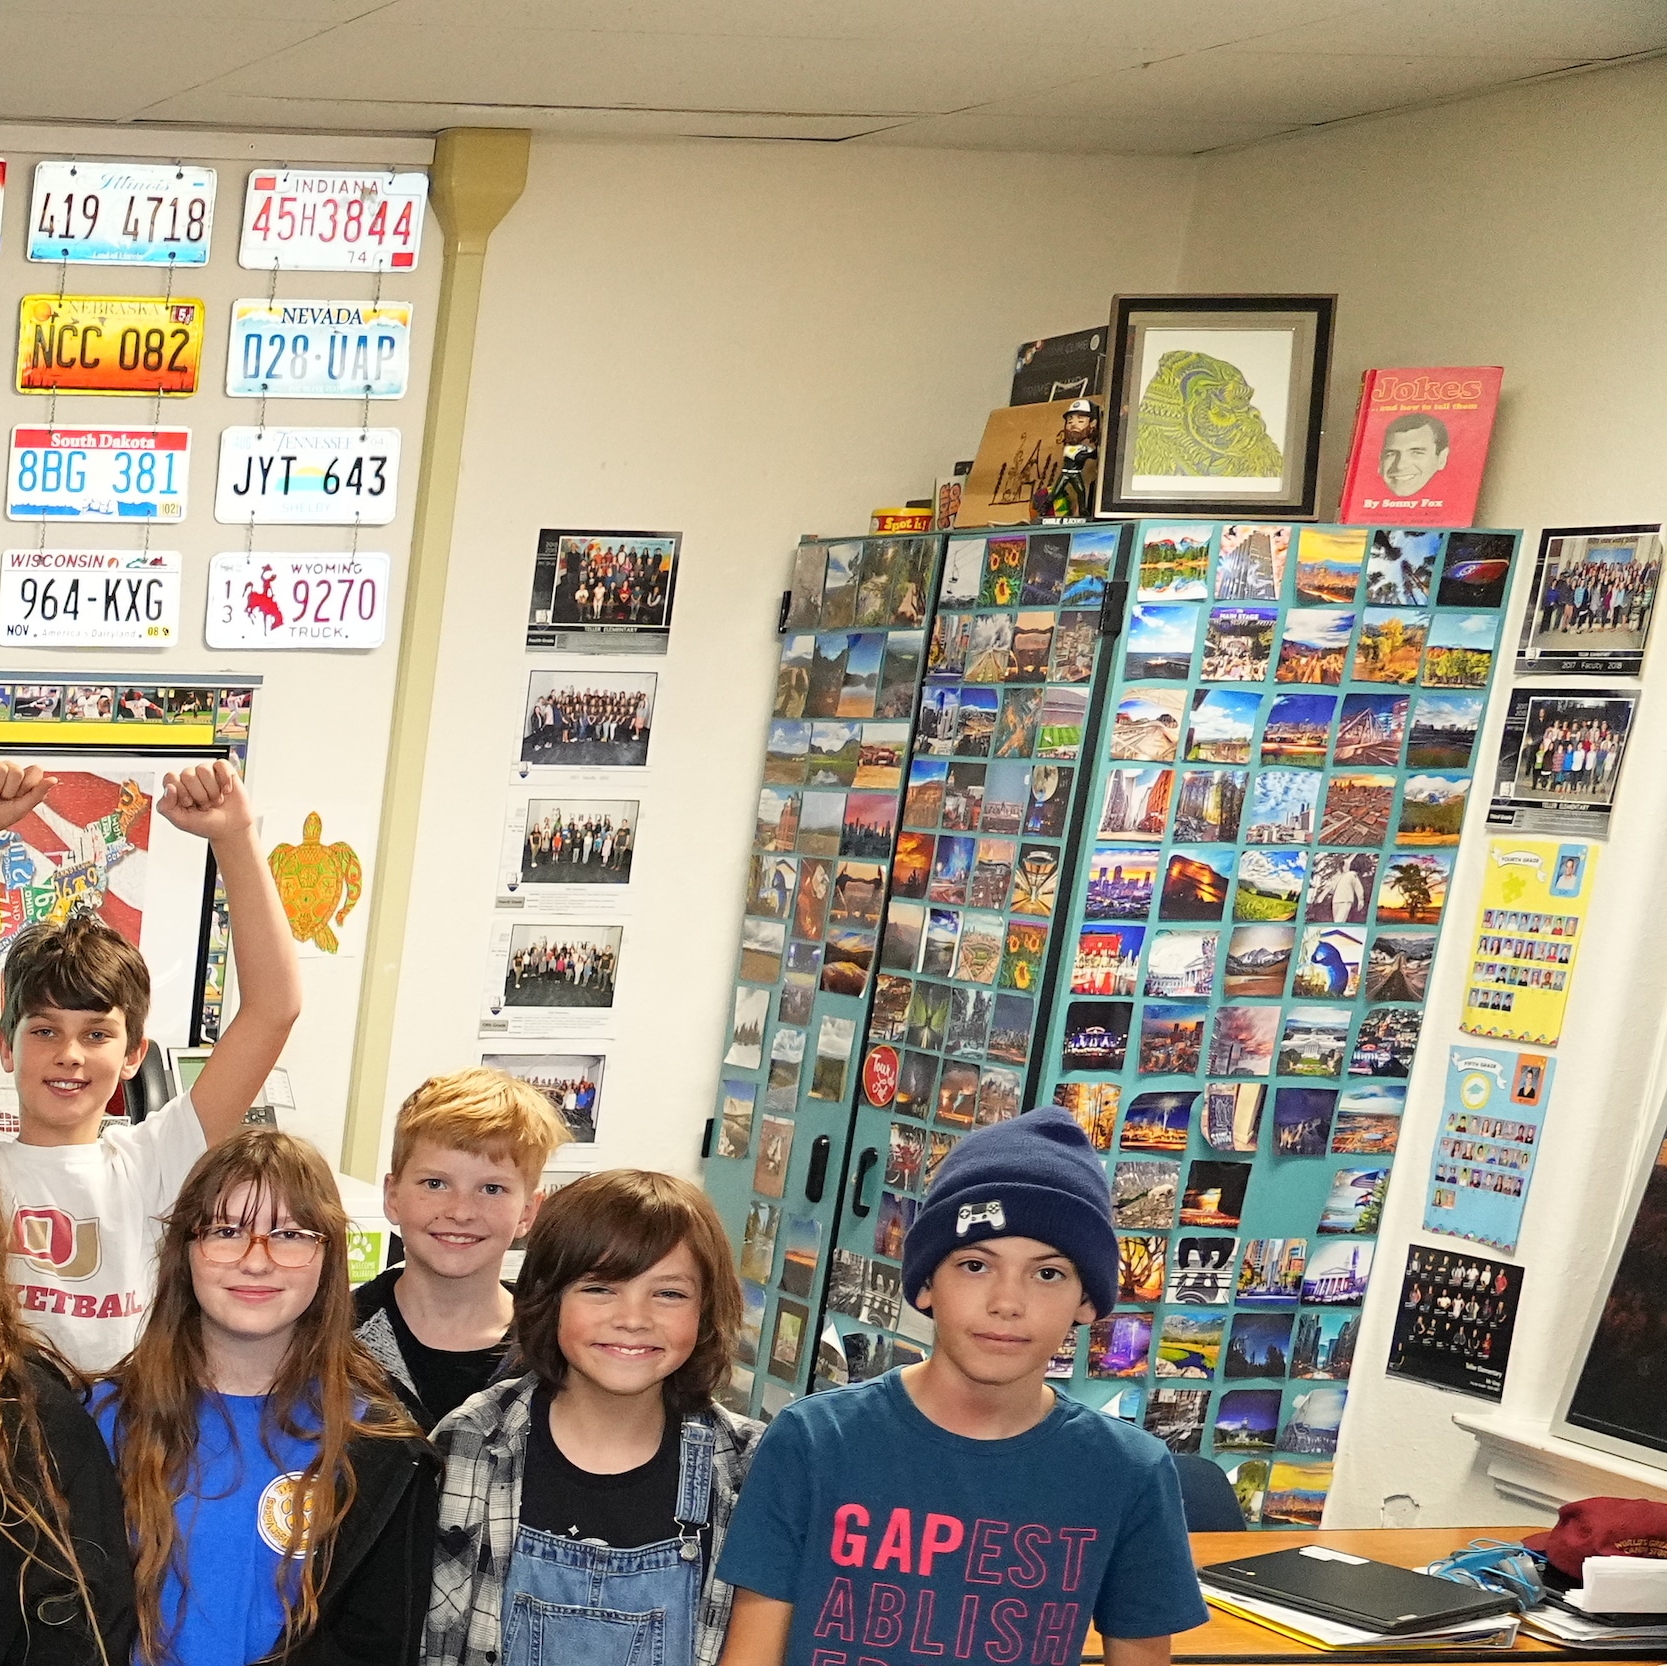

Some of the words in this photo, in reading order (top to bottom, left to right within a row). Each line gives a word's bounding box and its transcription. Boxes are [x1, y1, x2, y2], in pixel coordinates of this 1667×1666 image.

[280, 307, 362, 326] NEVADA
[1371, 377, 1481, 402] Jokes
[50, 433, 92, 450] South
[96, 435, 155, 450] Dakota
[233, 455, 297, 496] JYT
[323, 456, 387, 495] 643
[1363, 500, 1379, 509] By
[1382, 499, 1418, 508] Sonny
[1421, 499, 1443, 507] Fox
[884, 517, 912, 533] Spot
[290, 562, 363, 577] WYOMING
[21, 580, 164, 623] 964-KXG
[293, 578, 376, 623] 9270
